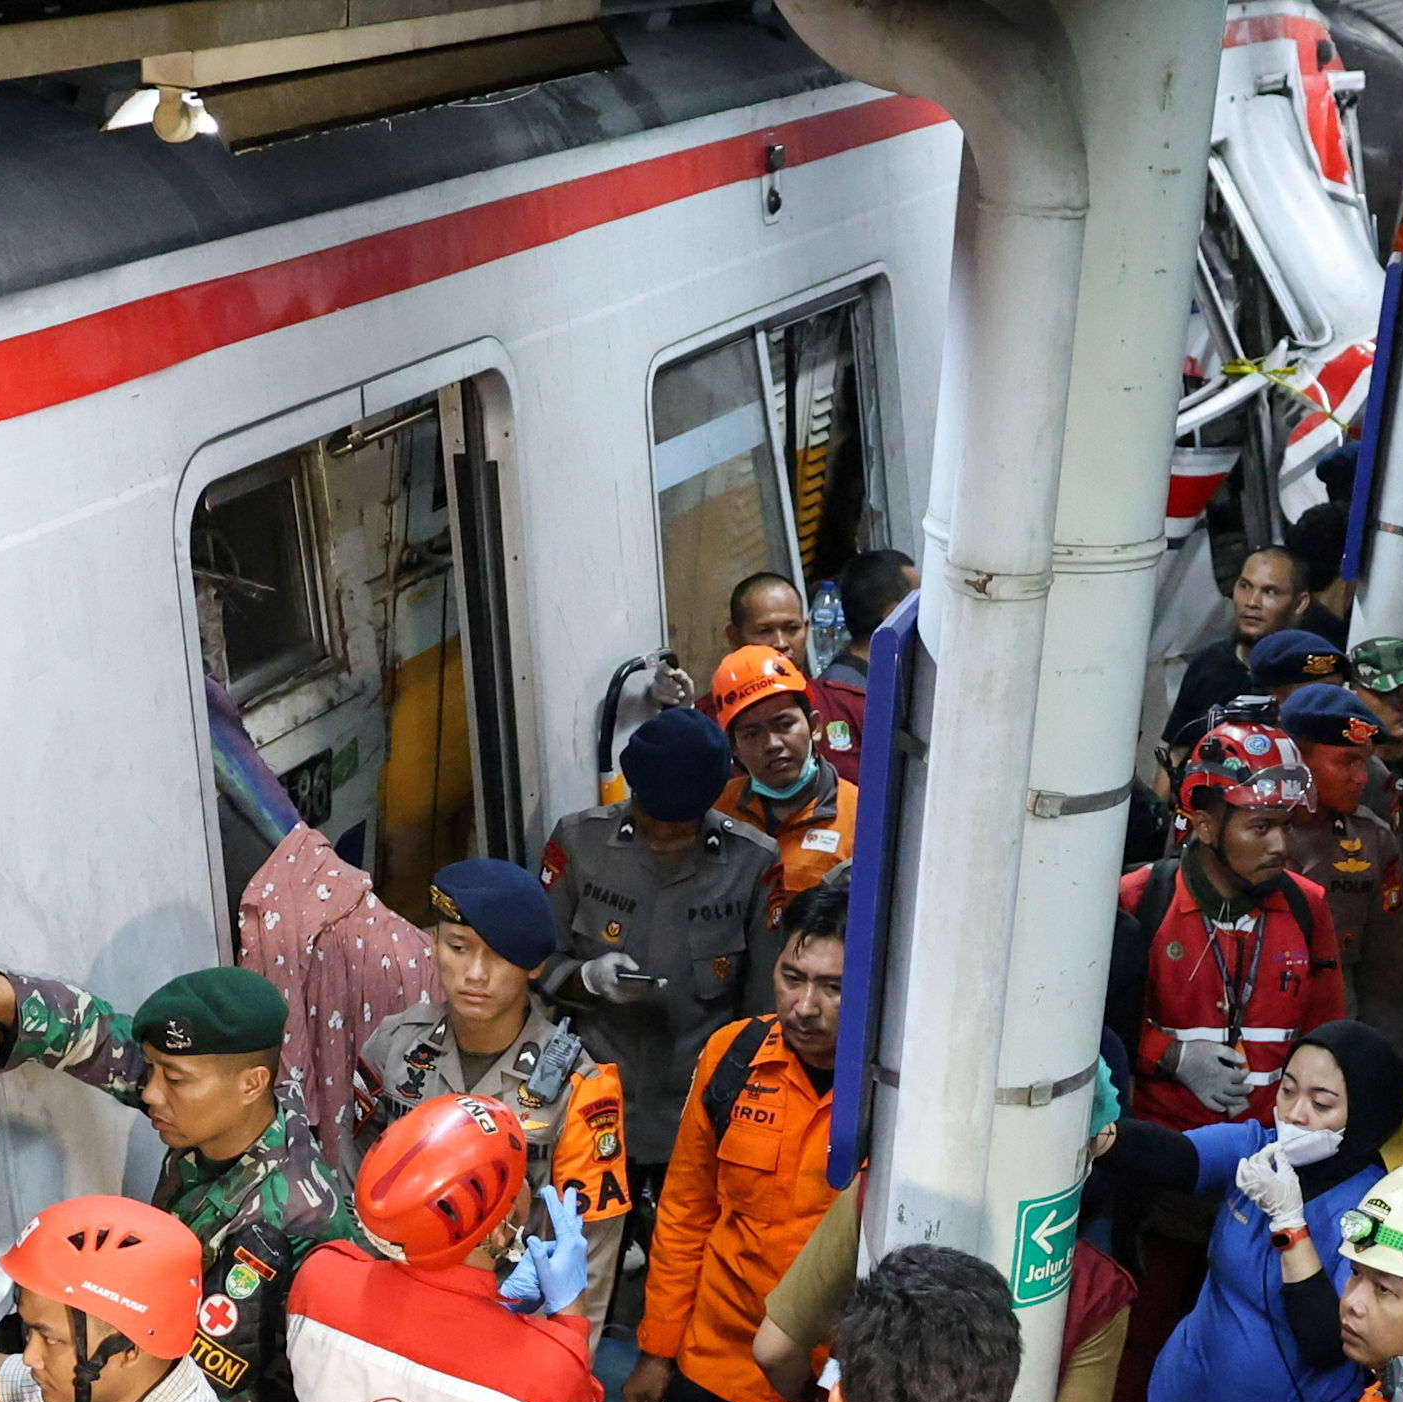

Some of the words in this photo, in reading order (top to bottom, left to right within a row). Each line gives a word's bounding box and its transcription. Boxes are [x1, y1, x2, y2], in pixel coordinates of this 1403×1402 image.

[738, 679, 775, 699] ACTION
[456, 1096, 498, 1134] PMI
[1024, 1257, 1065, 1283] Jalur
[81, 1280, 120, 1305] JAKARTA
[120, 1295, 149, 1314] PUSAT
